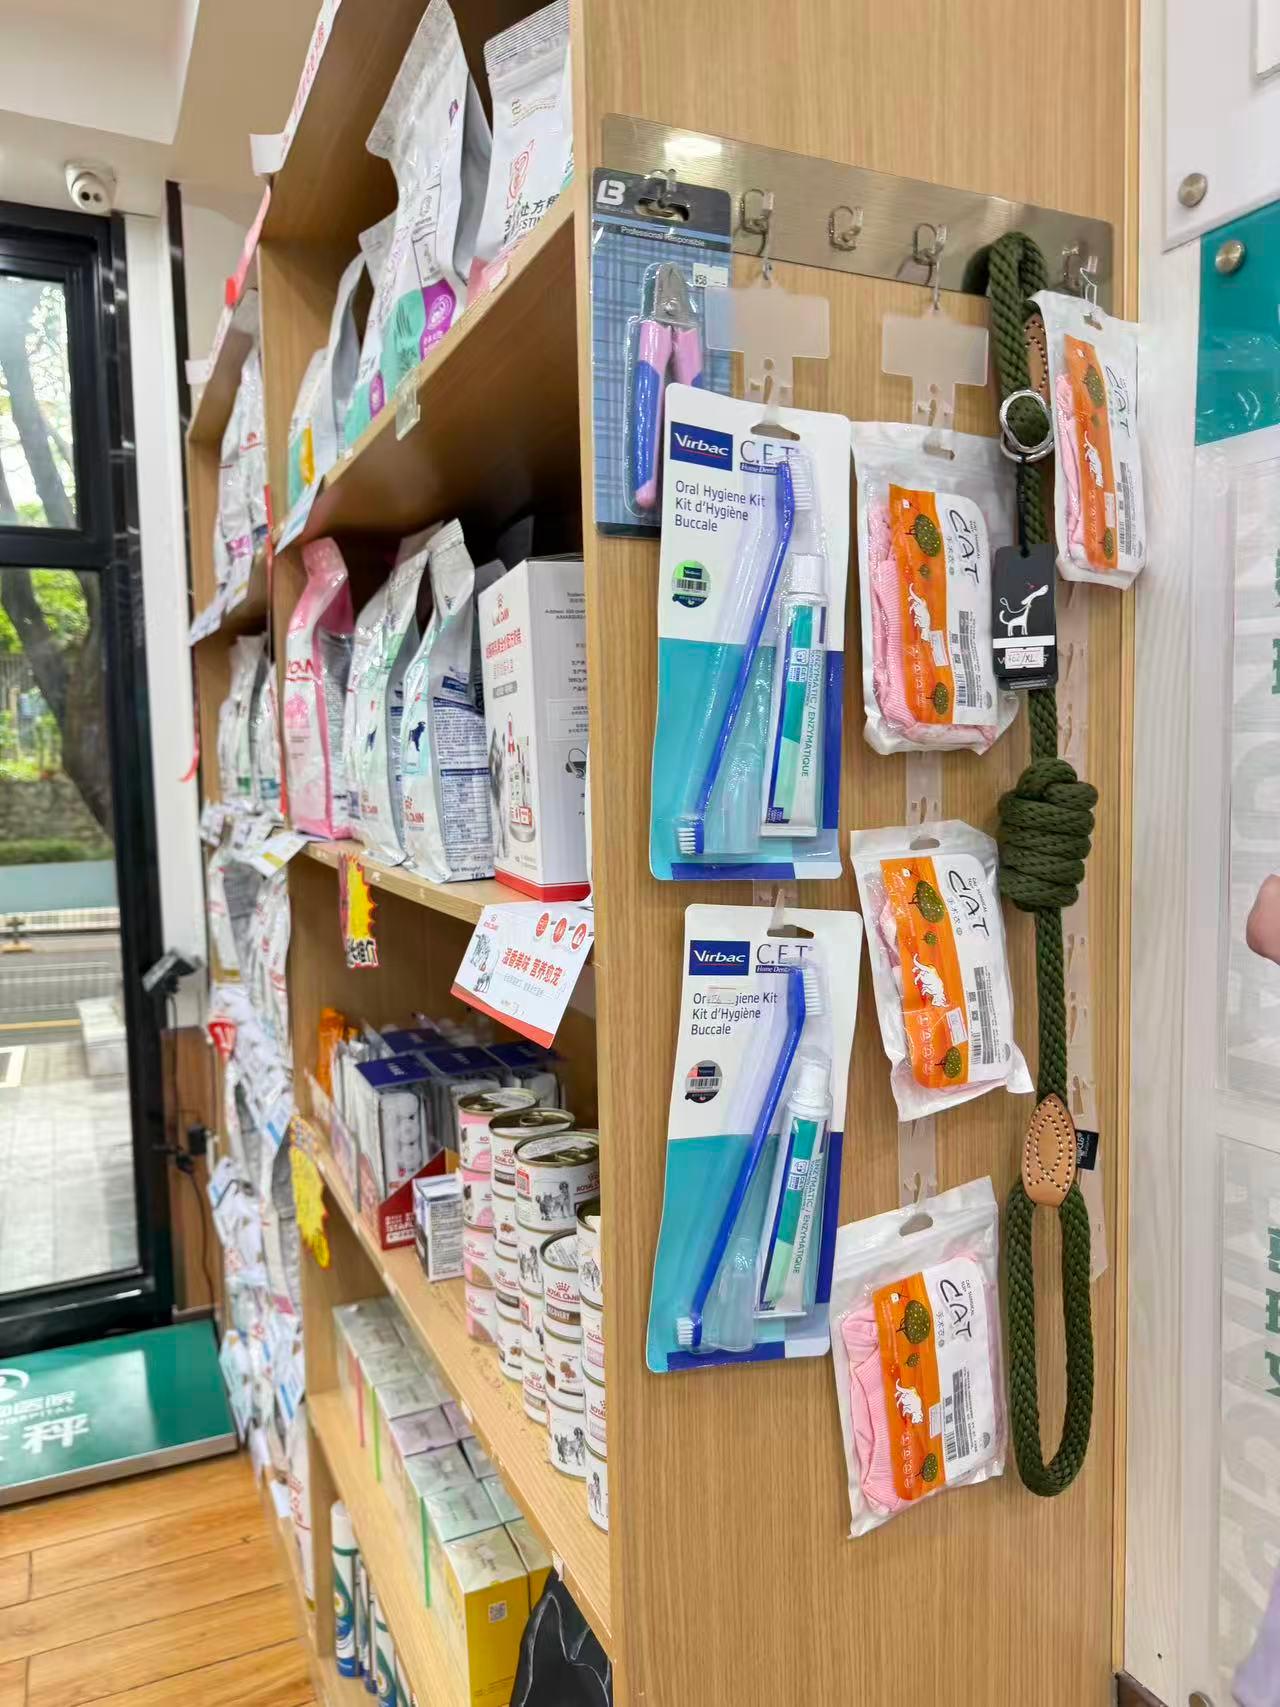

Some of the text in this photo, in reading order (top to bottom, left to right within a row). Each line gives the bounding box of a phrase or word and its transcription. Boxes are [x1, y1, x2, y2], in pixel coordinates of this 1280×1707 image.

[674, 432, 730, 457] Virbac
[676, 480, 766, 508] Oral Hygiene Kit
[676, 496, 749, 521] Kit d'Hygiène
[675, 514, 718, 532] Buccale
[949, 509, 980, 584] CAT
[801, 711, 815, 777] ENZYMATIQUE
[948, 870, 989, 937] CAT
[694, 949, 746, 964] Virbac
[763, 992, 778, 1004] Kit
[692, 1007, 761, 1022] Kit d'Hygiène
[691, 1024, 731, 1036] Buccale
[793, 1214, 811, 1274] ENZYMATIQUE
[939, 1279, 972, 1338] CAT
